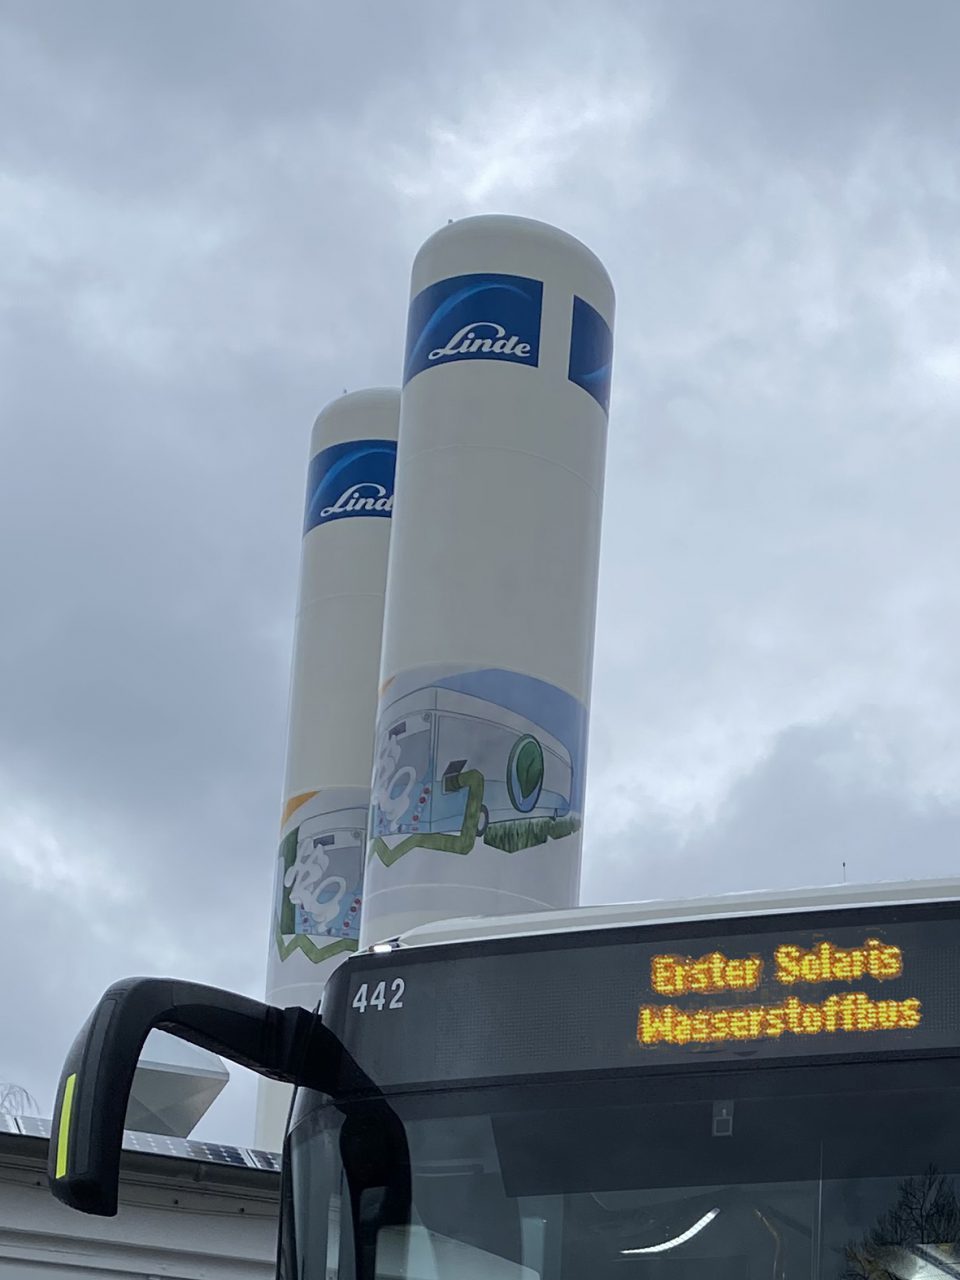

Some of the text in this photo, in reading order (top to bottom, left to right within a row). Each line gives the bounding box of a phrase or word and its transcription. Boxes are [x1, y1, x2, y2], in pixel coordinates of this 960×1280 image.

[428, 322, 531, 360] Linde
[320, 483, 393, 517] Lind
[651, 938, 902, 994] Erster Solaris
[353, 978, 405, 1013] 442
[638, 993, 921, 1046] Wasserstoffbus
